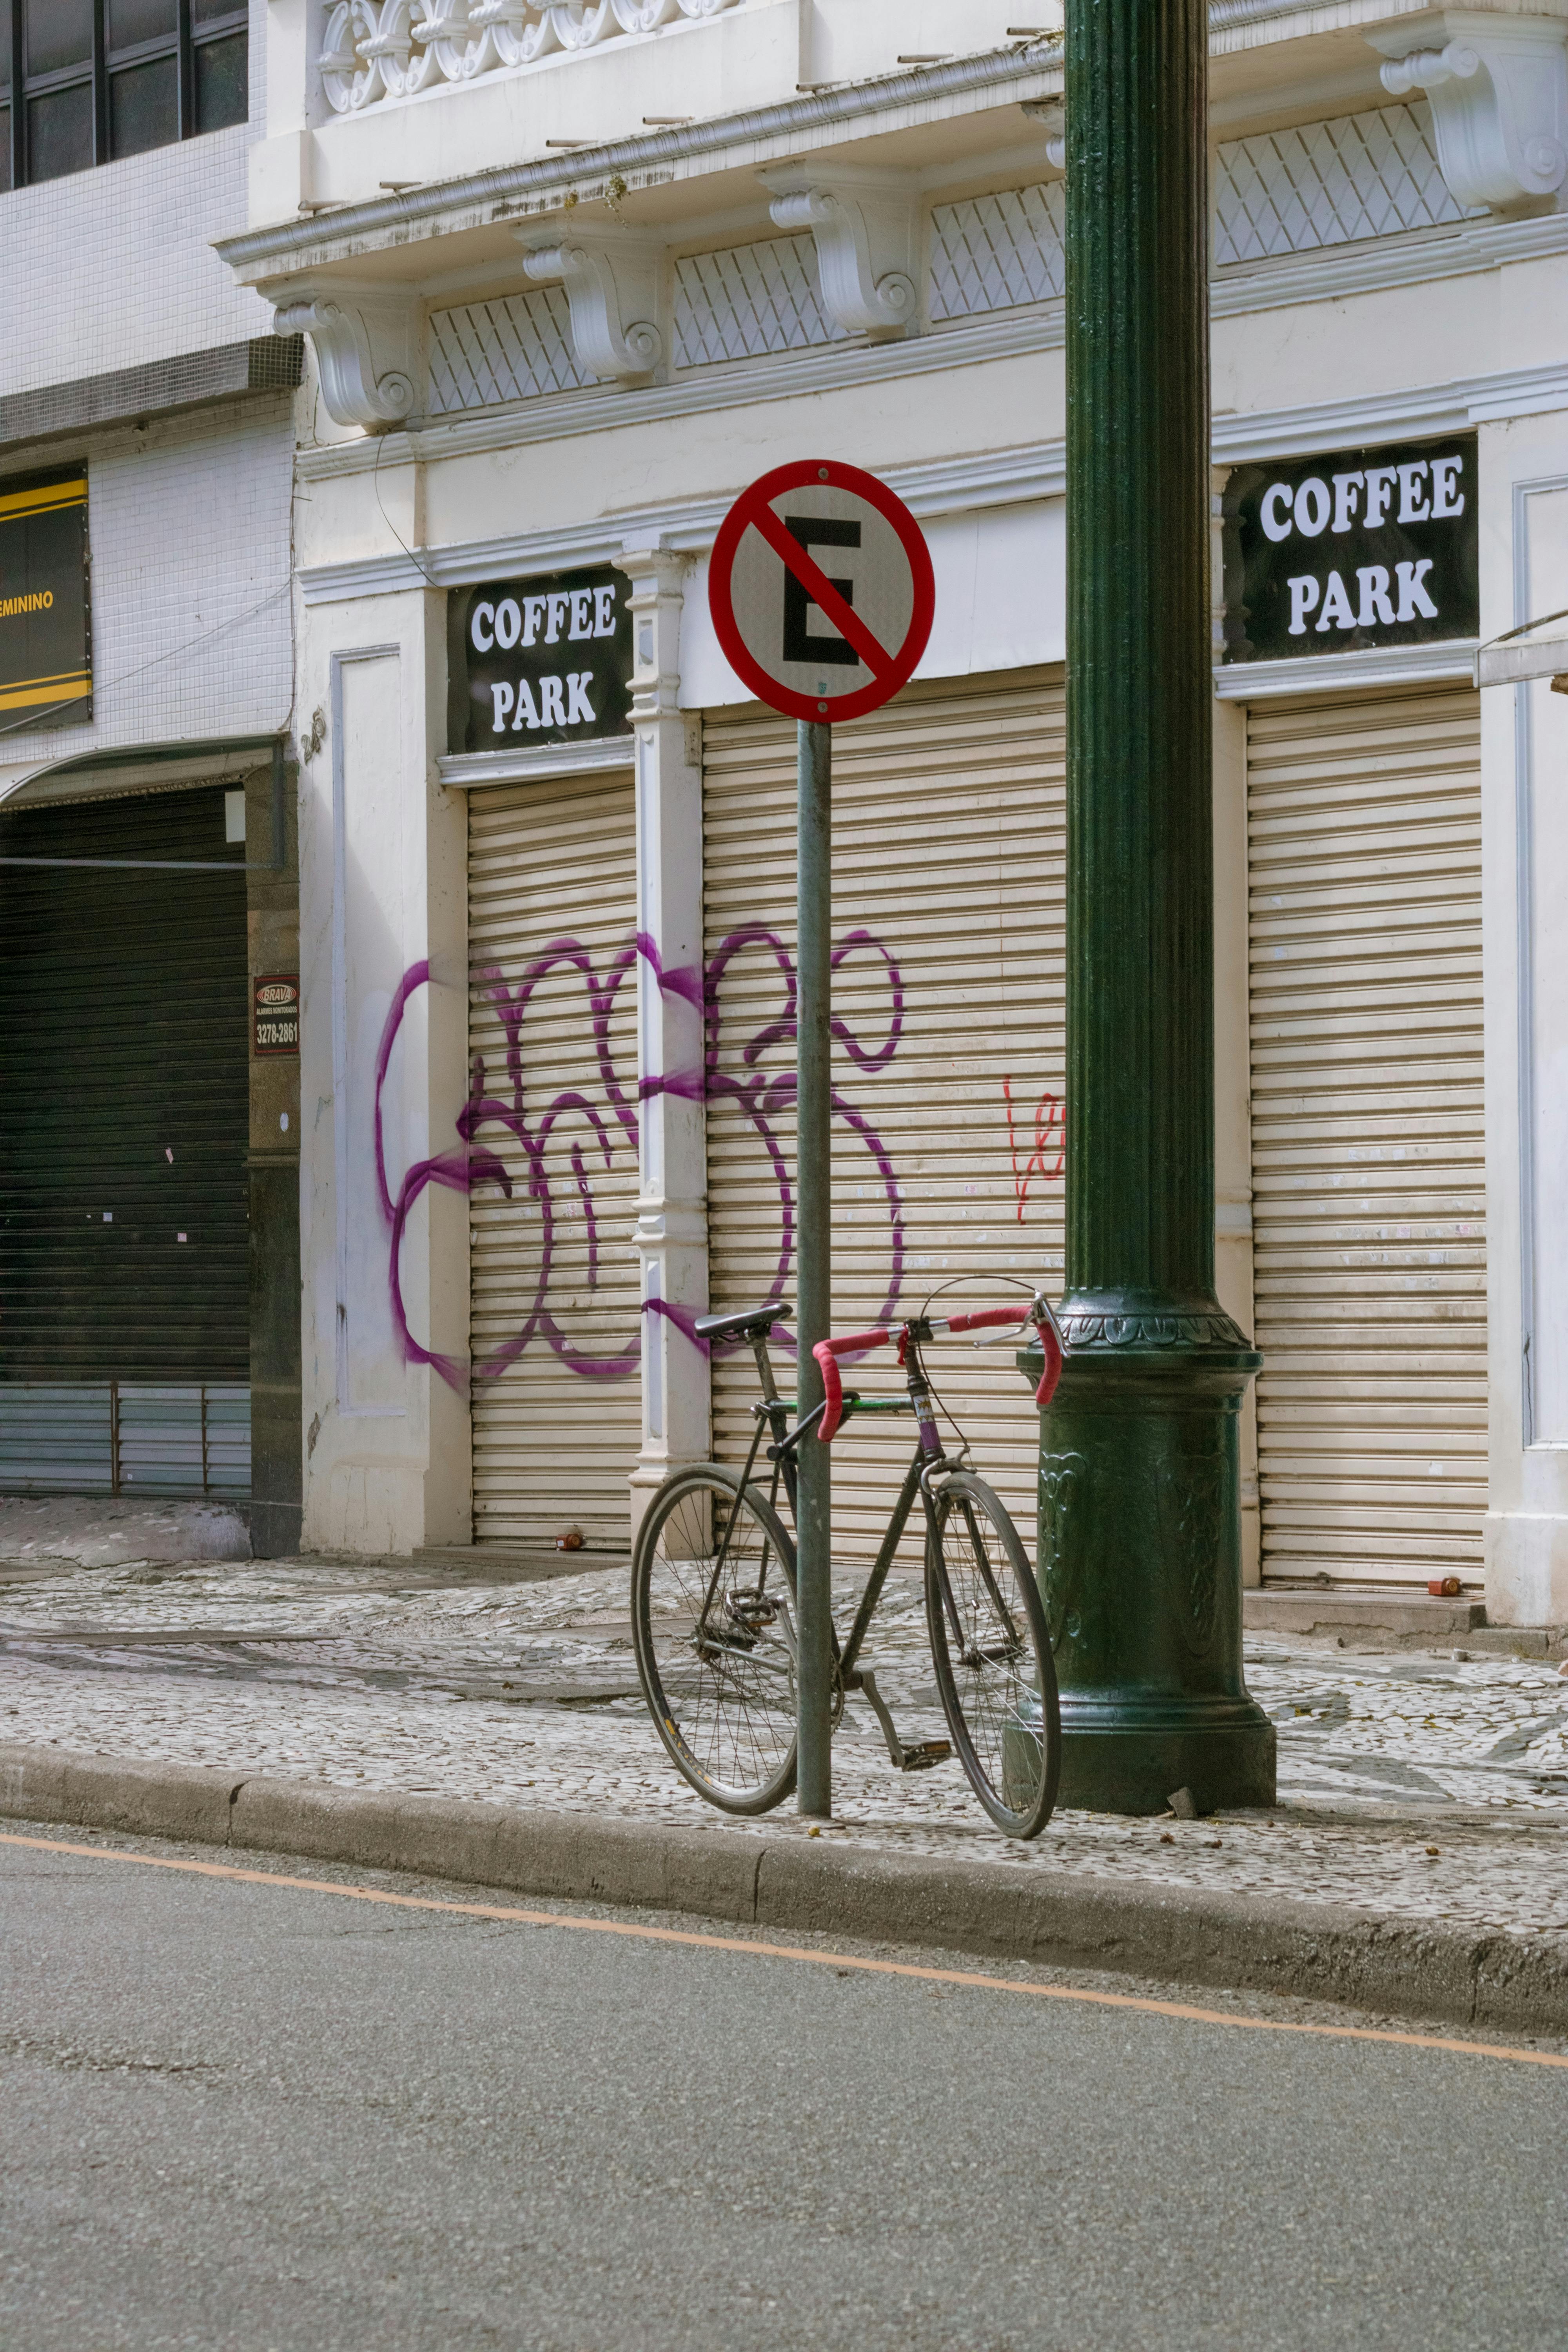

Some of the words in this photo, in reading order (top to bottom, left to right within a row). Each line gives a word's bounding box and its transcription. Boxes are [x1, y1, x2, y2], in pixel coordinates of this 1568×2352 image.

[1260, 455, 1465, 542] COFFEE
[471, 584, 616, 652] COFFEE
[783, 515, 861, 666] E
[1287, 559, 1438, 635] PARK
[491, 671, 596, 732] PARK
[264, 988, 292, 1001] BRAVA
[273, 1006, 297, 1014] MONITORADOS
[257, 1022, 297, 1044] 3278-2861
